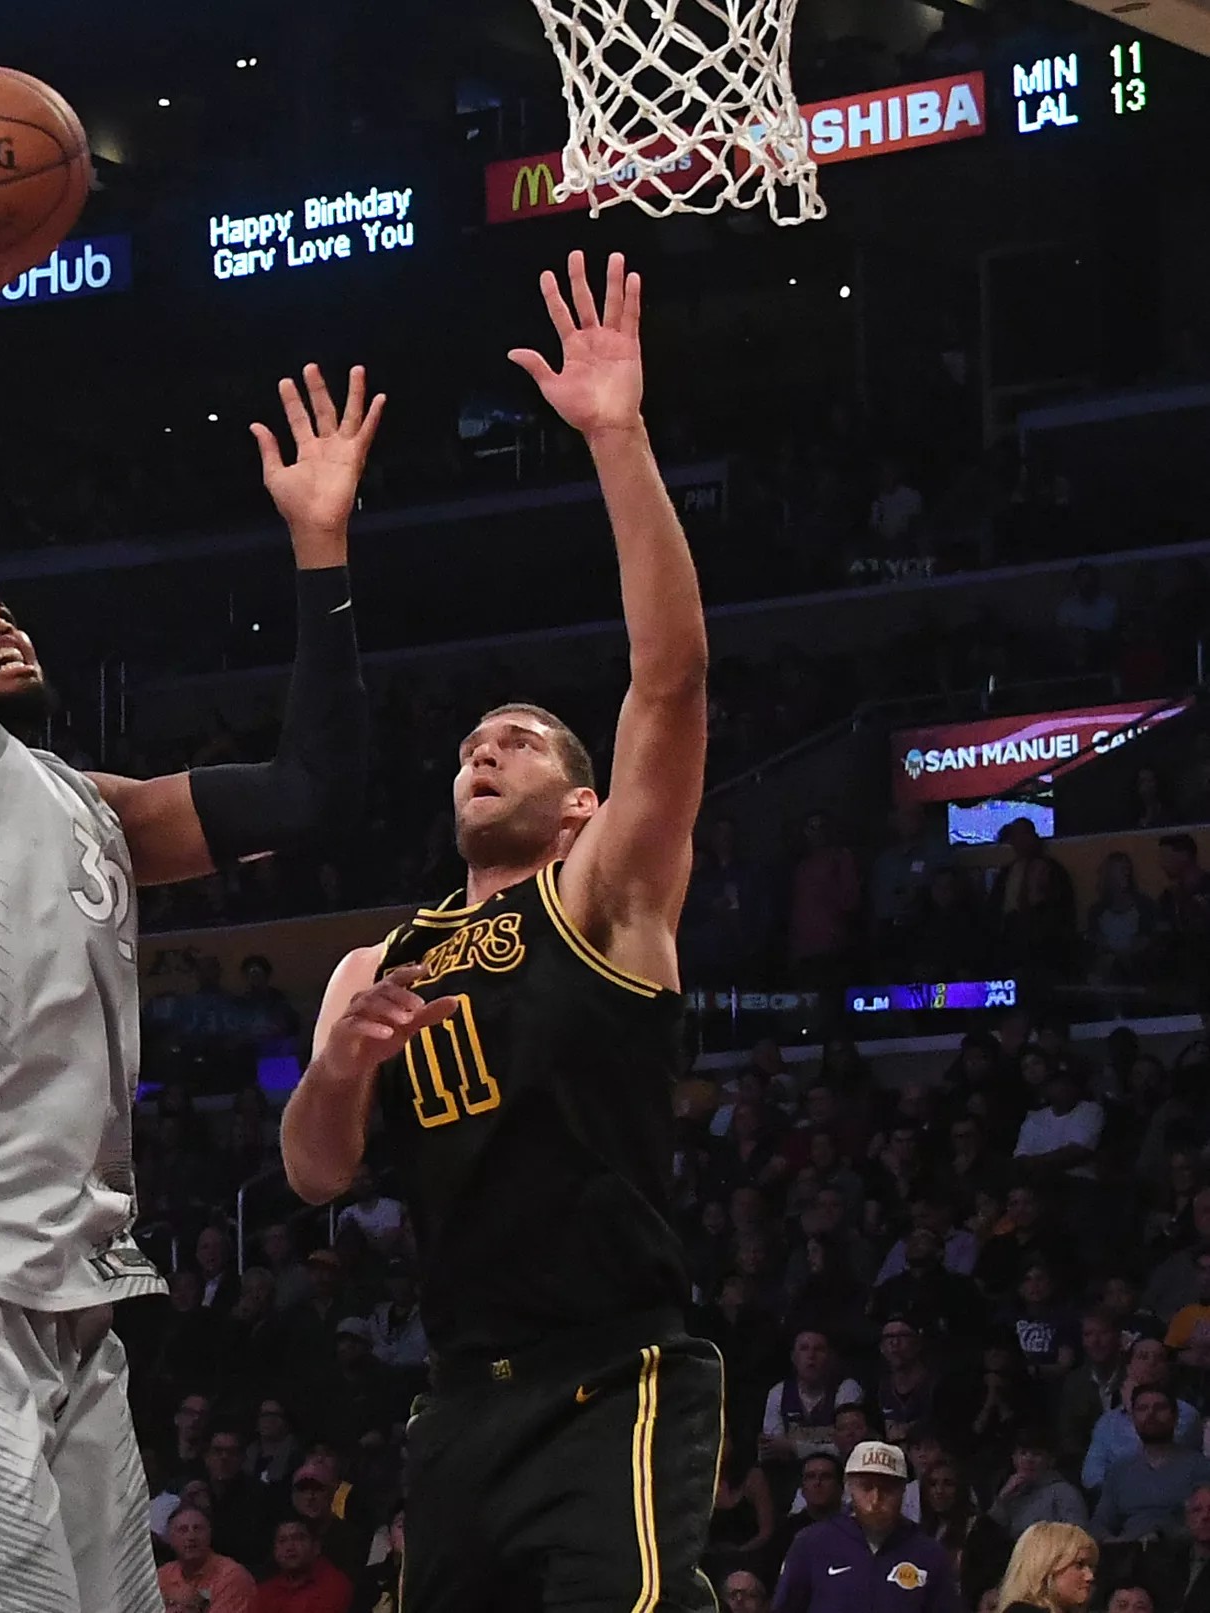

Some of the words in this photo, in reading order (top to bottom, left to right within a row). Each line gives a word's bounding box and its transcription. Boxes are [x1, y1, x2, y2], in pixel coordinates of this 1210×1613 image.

[1013, 53, 1077, 97] MIN
[1109, 41, 1141, 77] 11
[1018, 92, 1078, 133] LAL
[1110, 78, 1145, 114] 13
[210, 209, 294, 248] Happy
[304, 187, 413, 230] Birthday
[287, 234, 351, 267] Love
[362, 220, 414, 252] You
[925, 745, 976, 773] SAN
[405, 993, 501, 1129] 11
